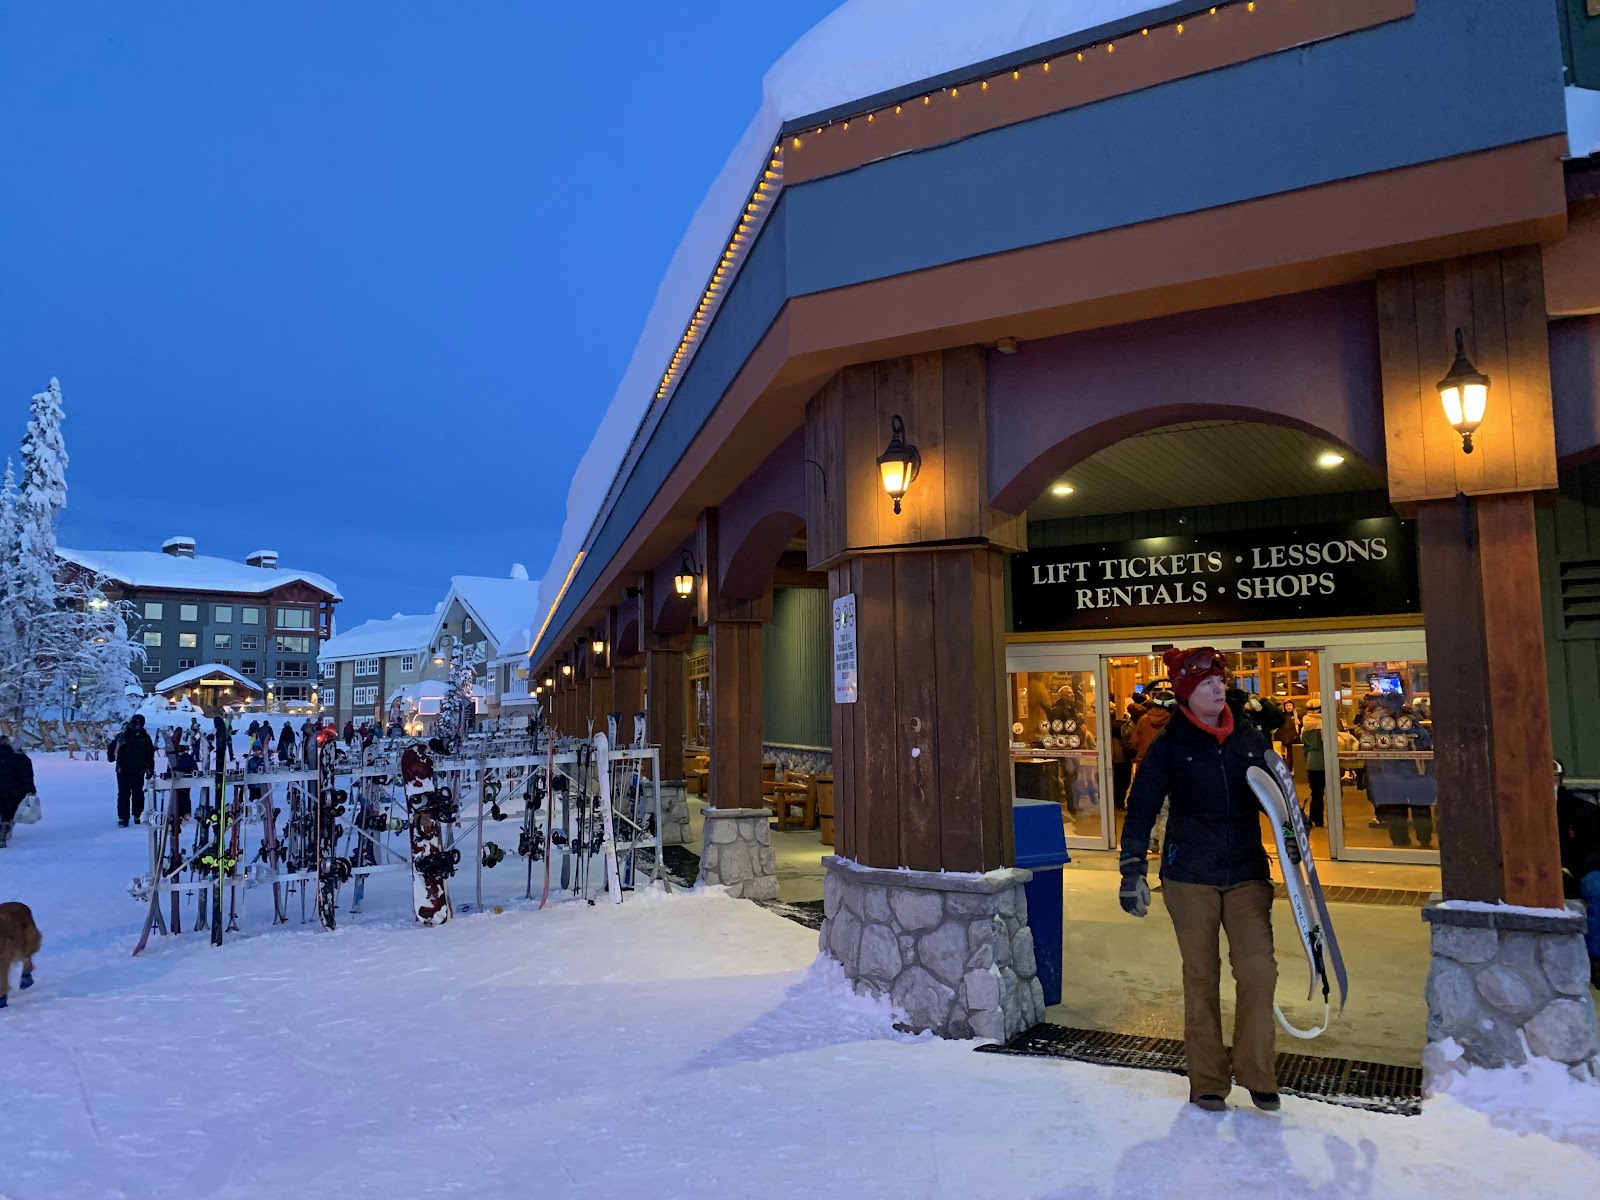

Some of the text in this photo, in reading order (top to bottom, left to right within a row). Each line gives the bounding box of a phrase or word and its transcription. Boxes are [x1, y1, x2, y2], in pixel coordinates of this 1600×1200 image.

[1031, 538, 1388, 585] LIFT TICKETS LESSONS
[1075, 572, 1335, 610] RENTALS SHOPS
[1275, 760, 1314, 873] RALSTON
